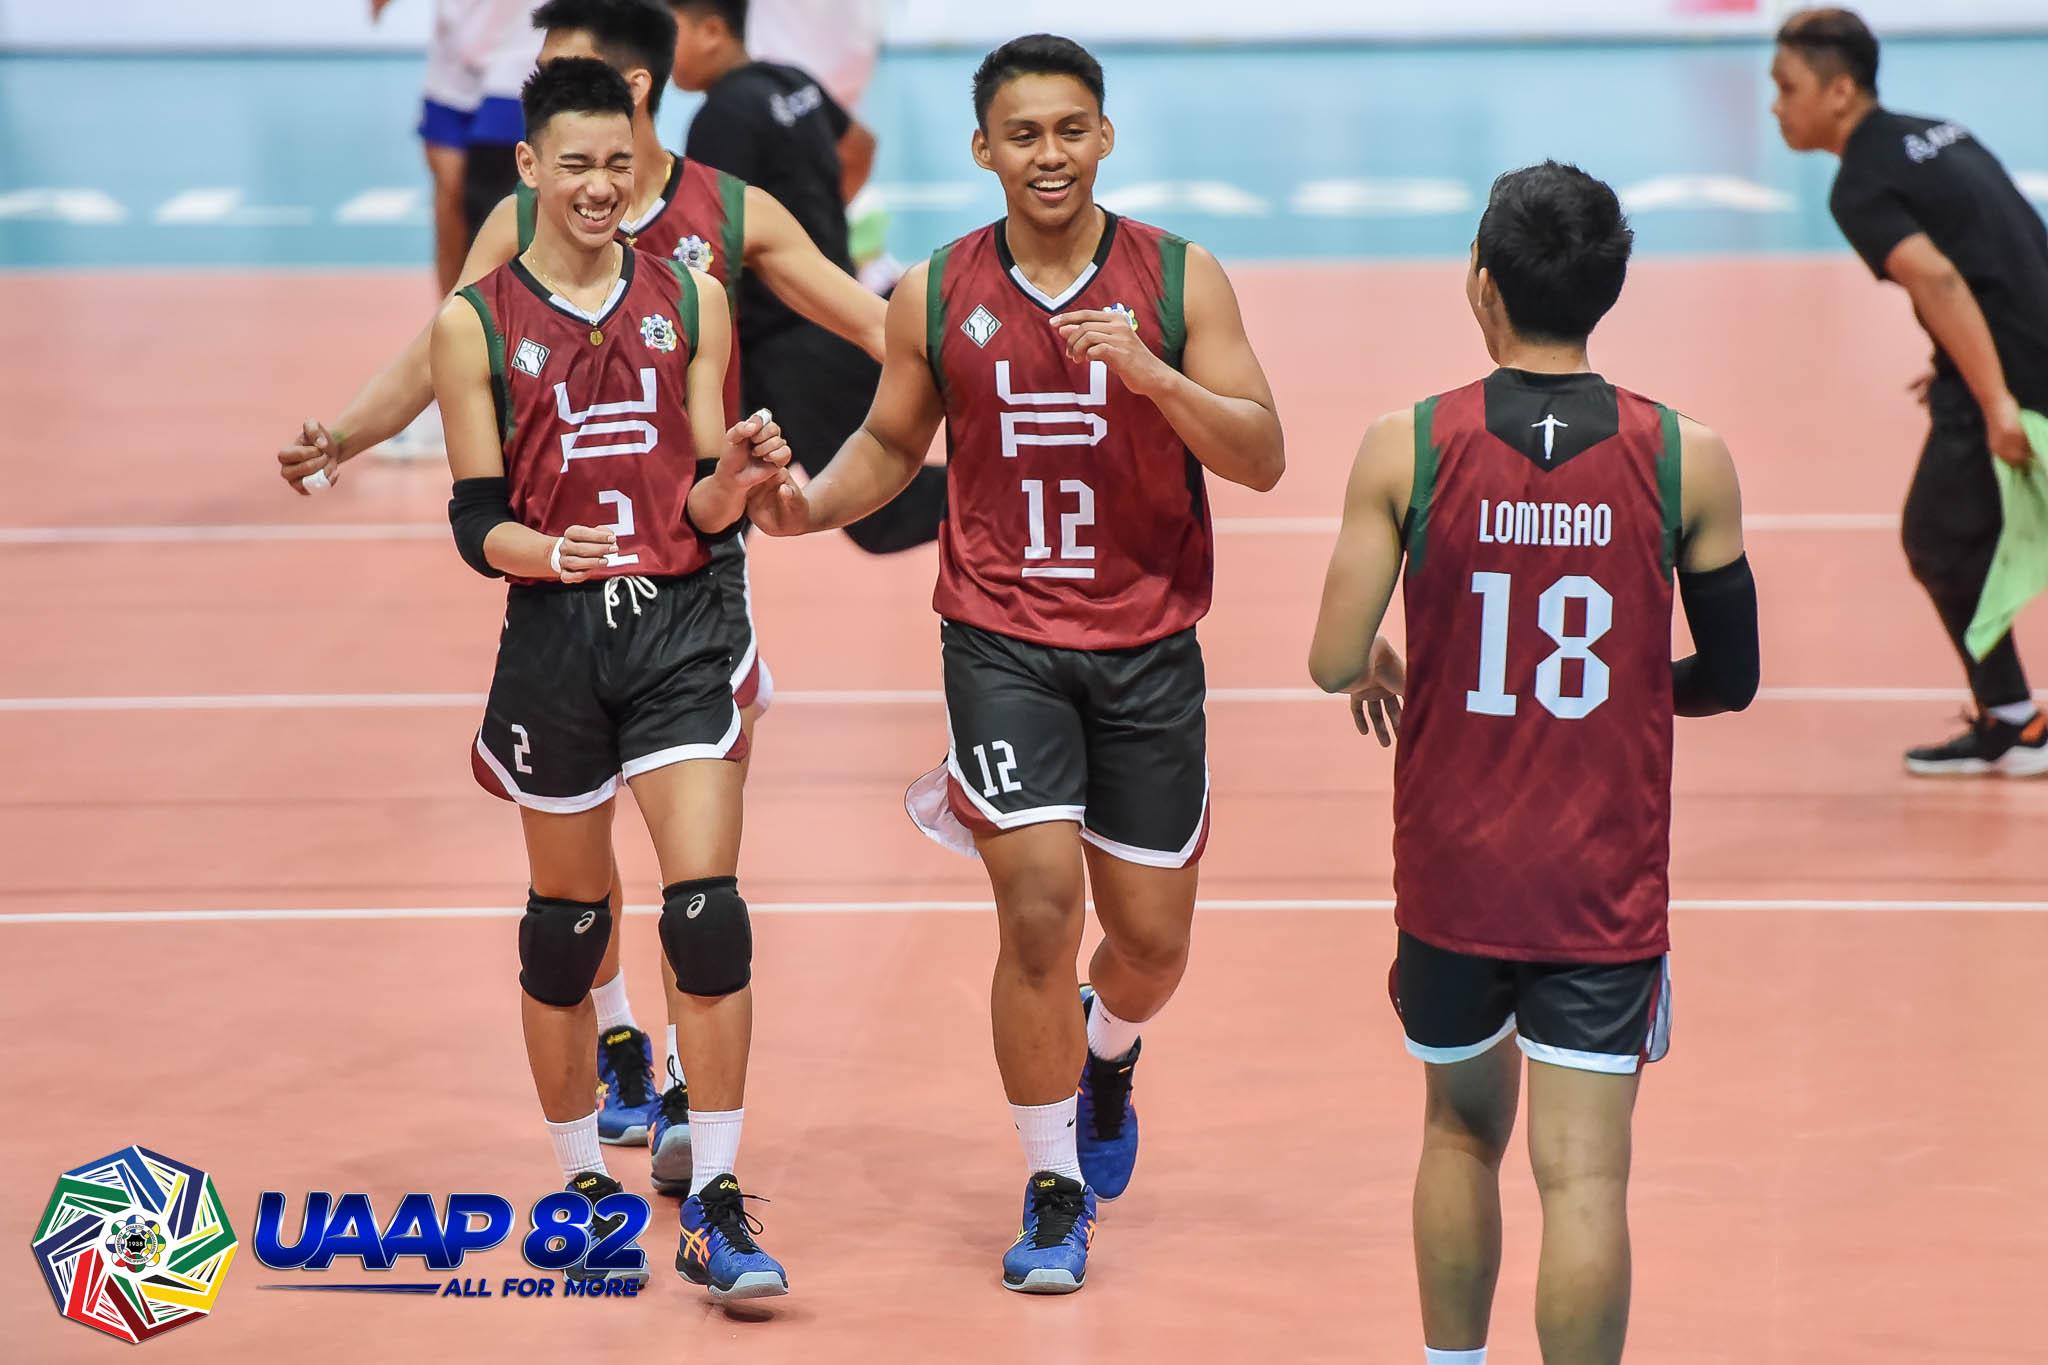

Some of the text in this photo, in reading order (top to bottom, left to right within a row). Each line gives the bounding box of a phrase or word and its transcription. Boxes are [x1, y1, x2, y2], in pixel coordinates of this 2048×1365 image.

[599, 489, 640, 568] 2
[1021, 479, 1095, 559] 12
[1479, 499, 1612, 546] LOMIBAO
[1466, 571, 1613, 719] 18
[511, 723, 533, 774] 2
[973, 740, 1022, 798] 12
